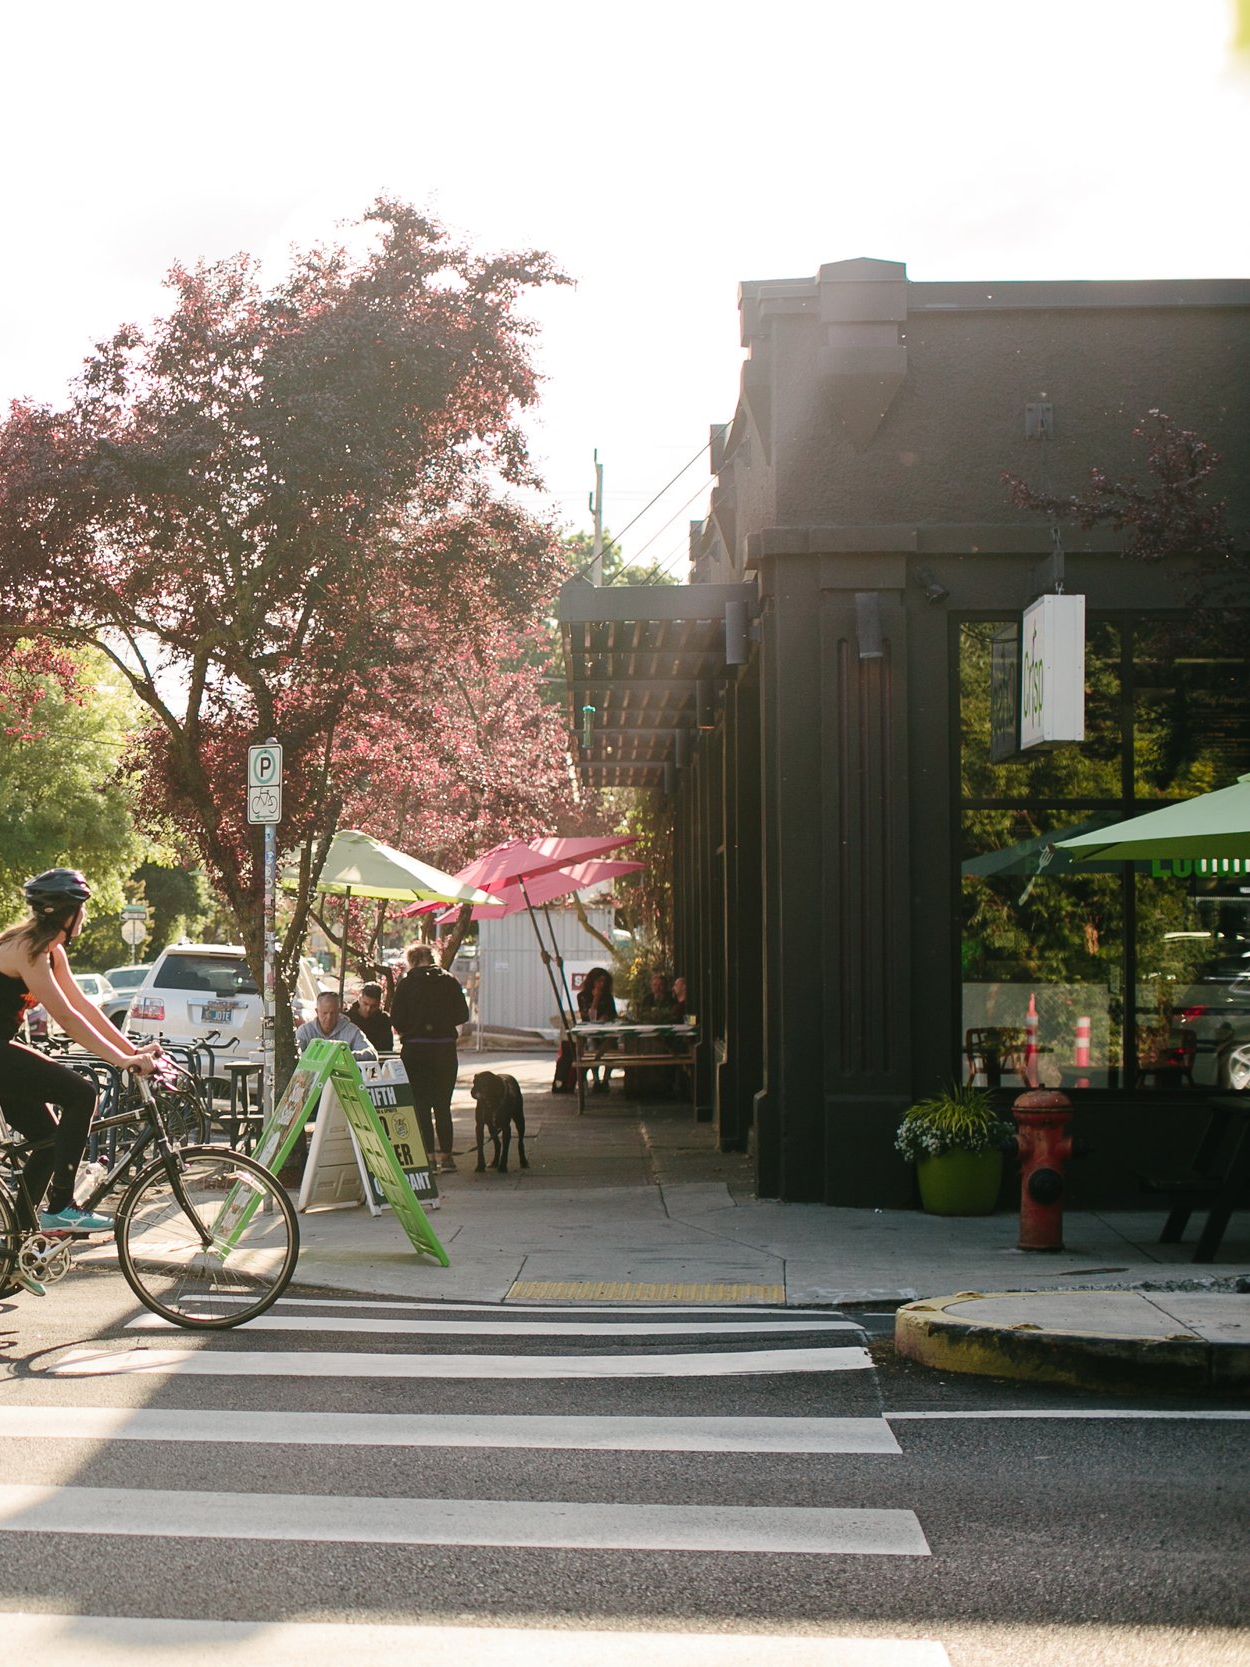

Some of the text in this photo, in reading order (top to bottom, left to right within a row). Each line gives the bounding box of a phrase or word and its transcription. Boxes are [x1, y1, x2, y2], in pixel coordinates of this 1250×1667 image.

[261, 757, 271, 777] P
[366, 1086, 397, 1107] IFTH
[393, 1143, 415, 1166] ER
[373, 1171, 432, 1197] QANT
